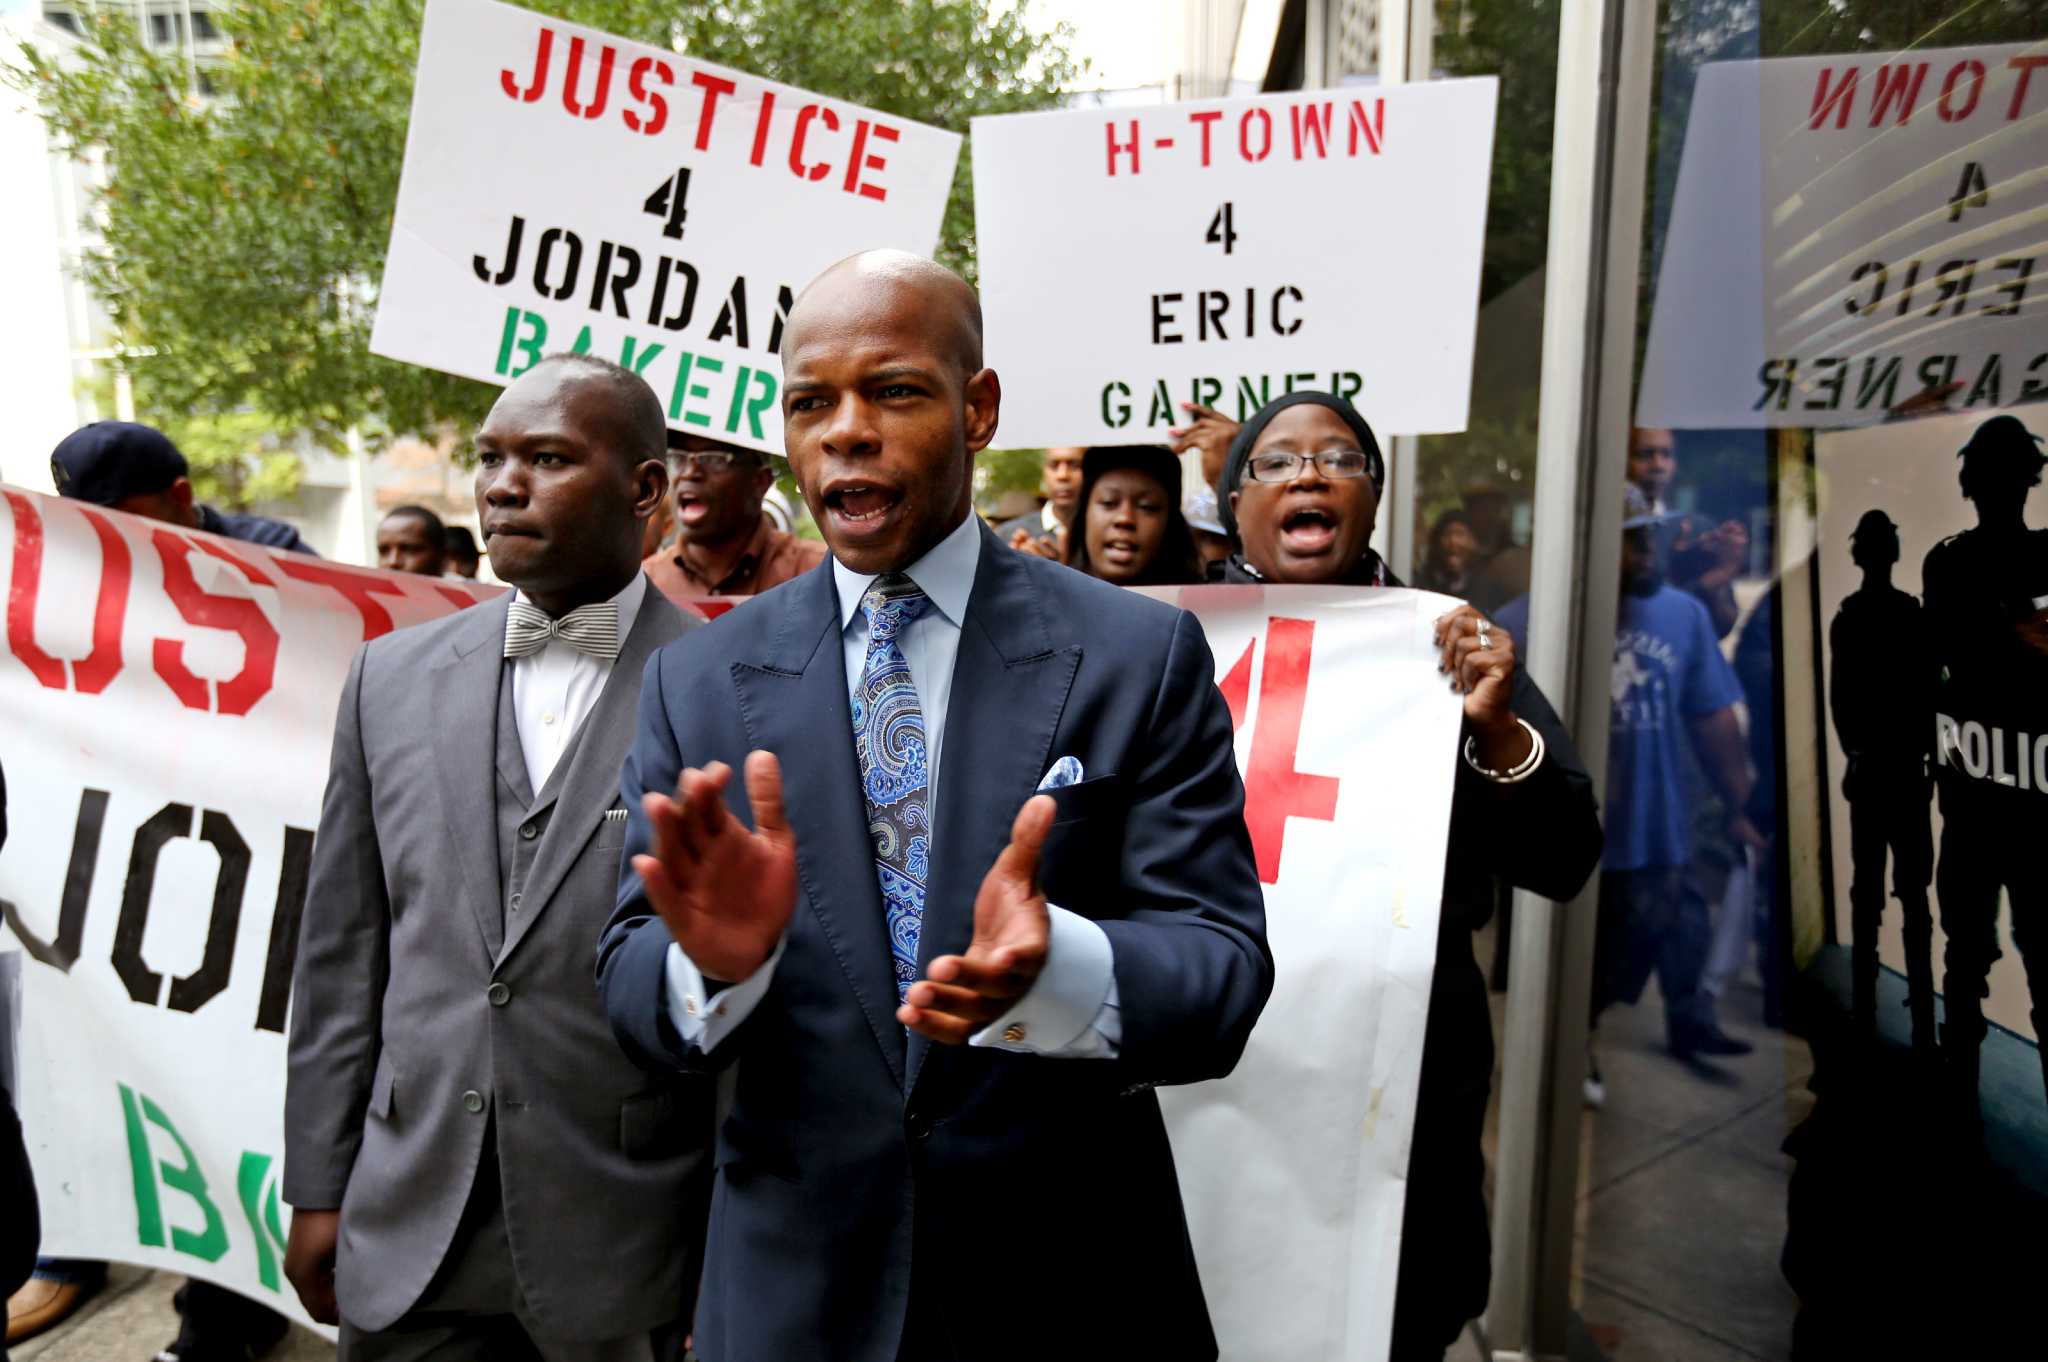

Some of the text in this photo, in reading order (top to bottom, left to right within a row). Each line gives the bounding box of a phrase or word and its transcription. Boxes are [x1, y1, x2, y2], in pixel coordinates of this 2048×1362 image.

[501, 28, 900, 202] JUSTICE
[1105, 98, 1385, 176] H-TOWN
[643, 167, 691, 240] 4
[1206, 202, 1237, 255] 4
[1151, 286, 1304, 345] ERIC
